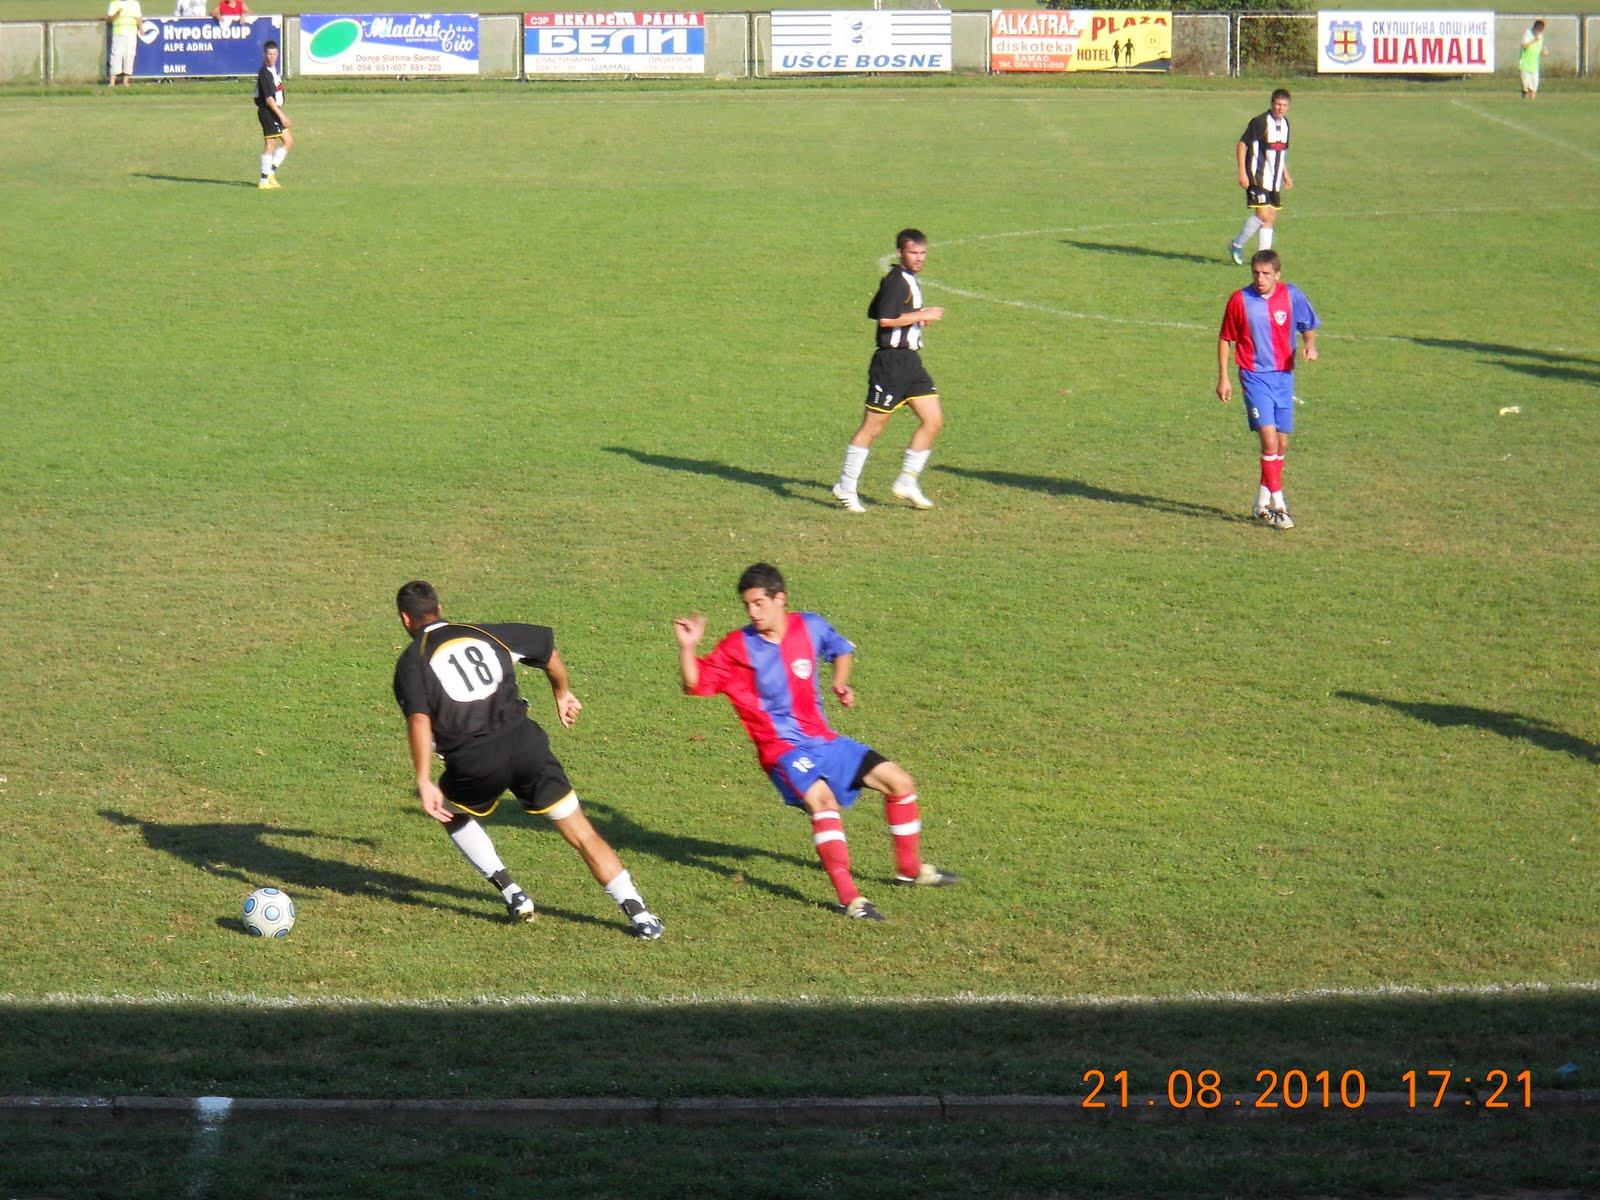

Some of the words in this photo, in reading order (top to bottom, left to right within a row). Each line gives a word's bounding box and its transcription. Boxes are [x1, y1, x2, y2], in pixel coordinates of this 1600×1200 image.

[997, 13, 1080, 36] ALKATRAZ
[1091, 15, 1168, 42] PLAZA
[163, 42, 185, 52] ALPE
[186, 42, 214, 52] ADRIA
[538, 28, 688, 54] БЕЛИ
[996, 40, 1073, 53] diskoteka
[1076, 48, 1111, 62] HOTEL
[1373, 37, 1487, 65] ШАМАЦ
[163, 64, 187, 74] BANK
[855, 54, 943, 69] BOSNE
[883, 394, 894, 407] 2
[447, 645, 494, 693] 18
